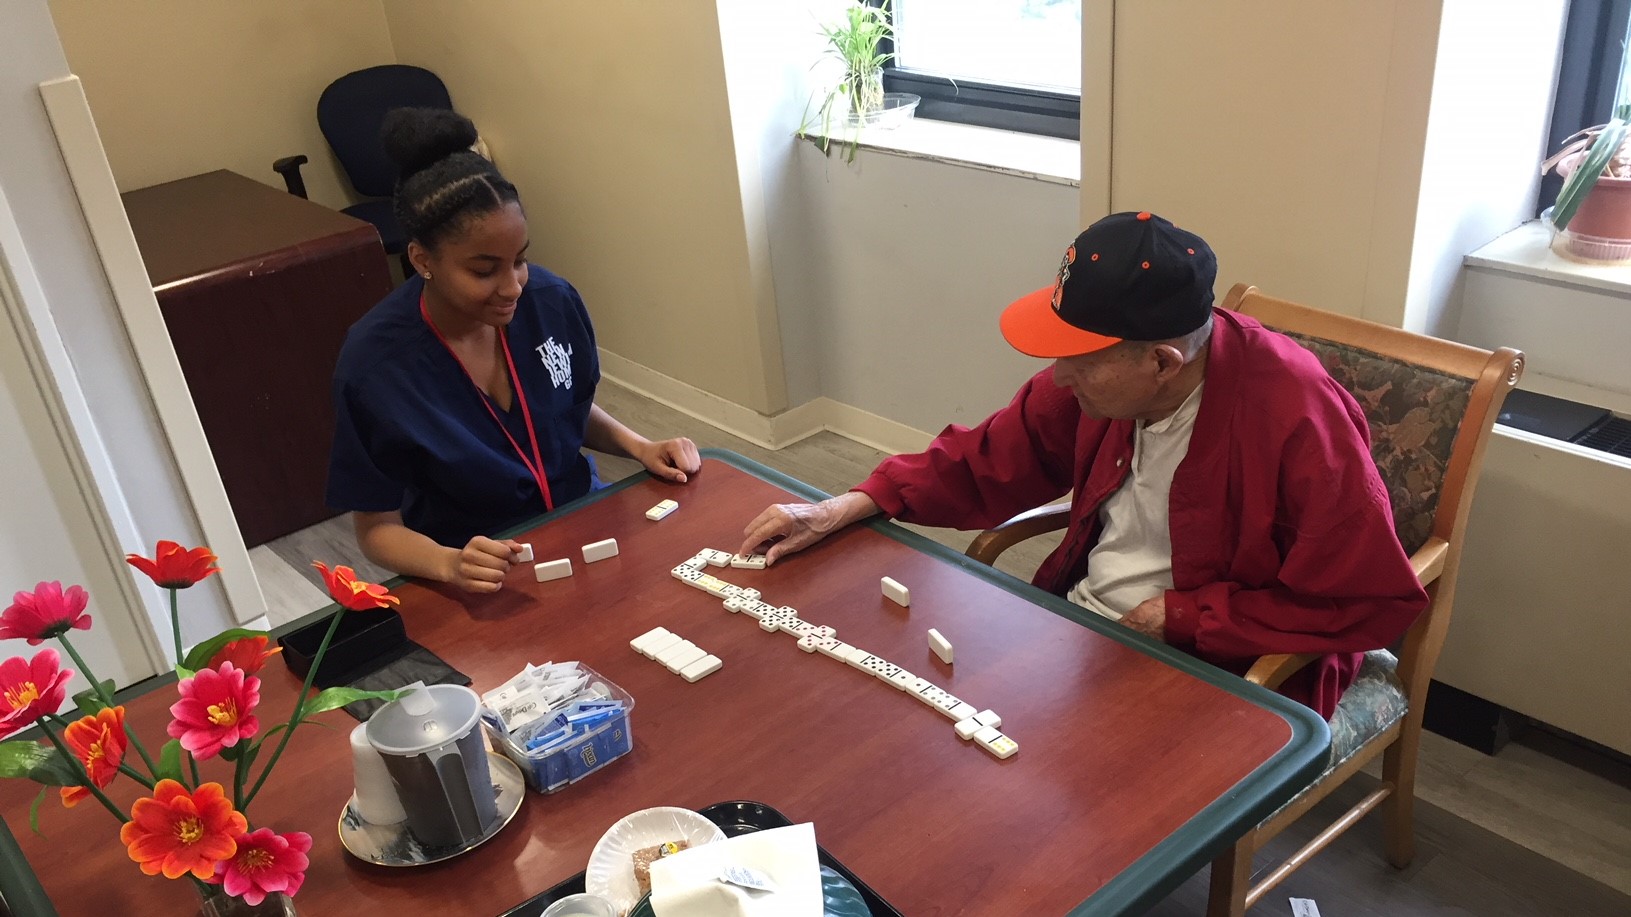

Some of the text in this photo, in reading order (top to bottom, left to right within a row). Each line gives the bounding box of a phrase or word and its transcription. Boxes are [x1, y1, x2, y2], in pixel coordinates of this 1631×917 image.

[535, 336, 556, 358] THE
[541, 343, 566, 369] NEW
[551, 365, 571, 389] HOM
